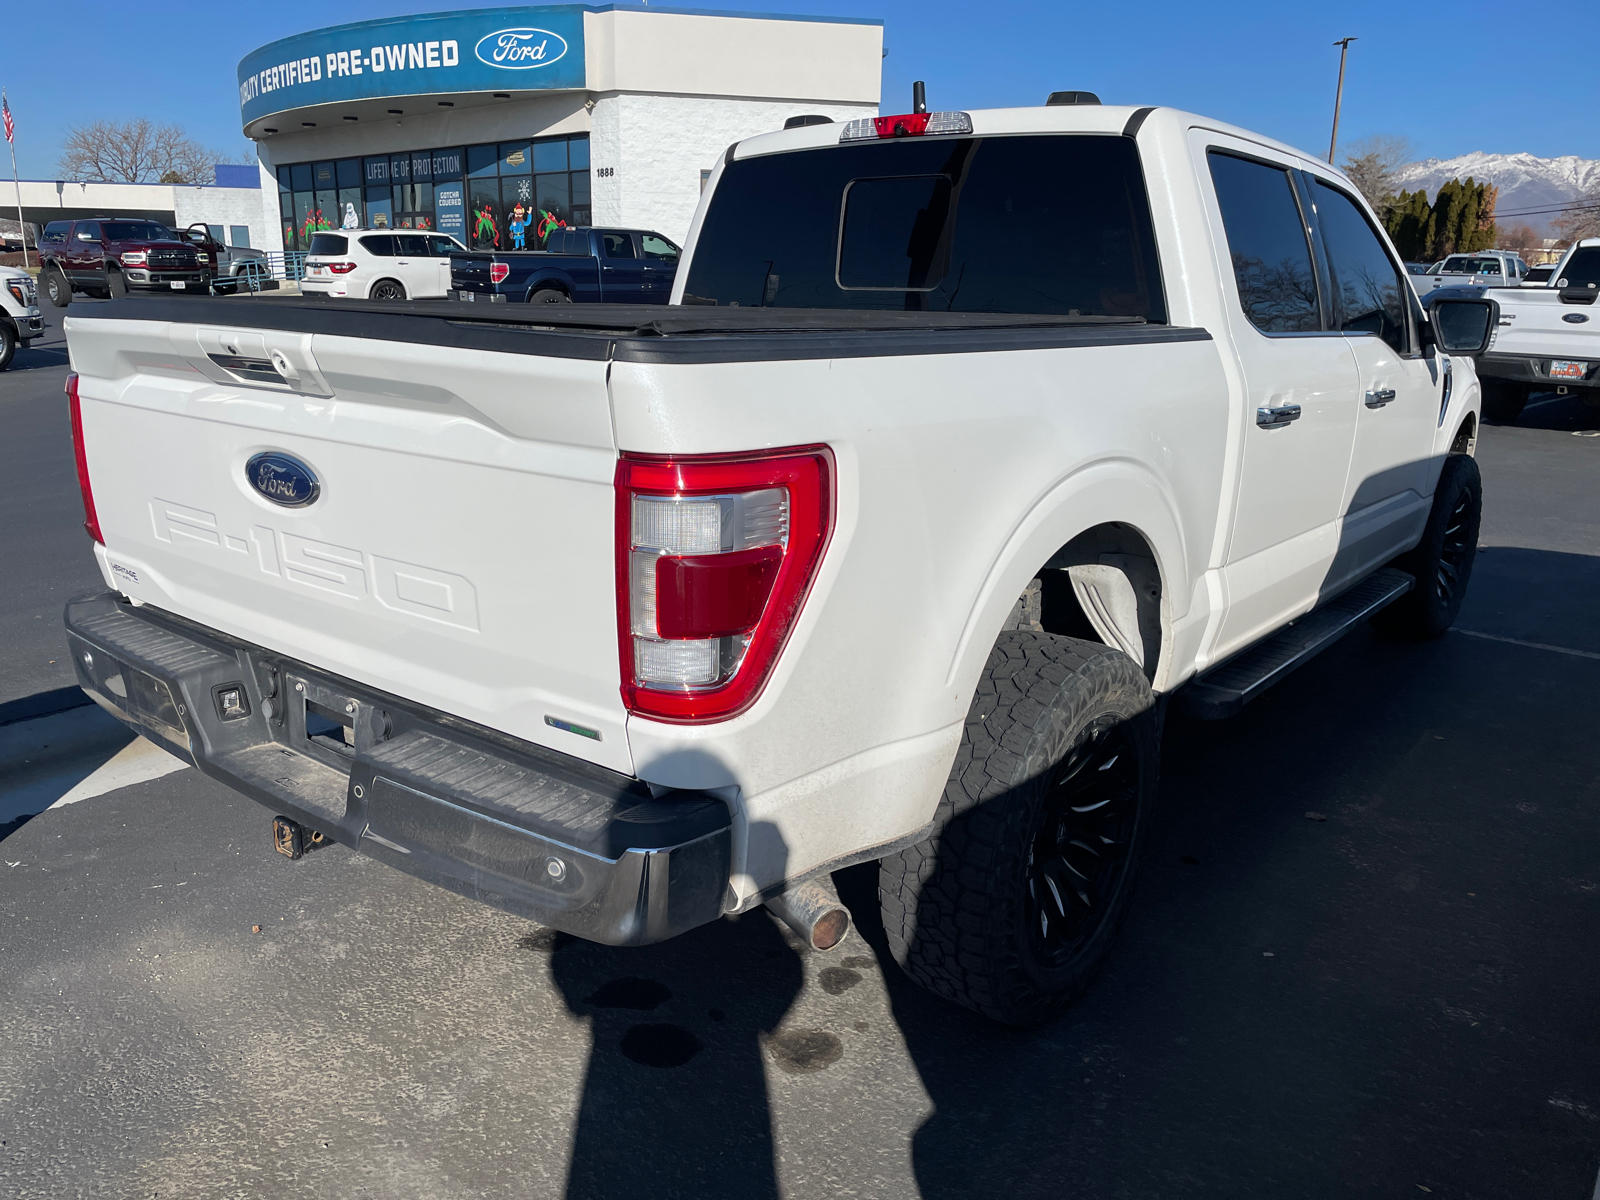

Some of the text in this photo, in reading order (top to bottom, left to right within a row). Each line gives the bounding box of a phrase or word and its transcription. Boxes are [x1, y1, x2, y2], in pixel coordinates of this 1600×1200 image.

[493, 33, 548, 62] Ford
[260, 55, 322, 94] CERTIFIED
[326, 40, 459, 78] PRE-OWNED
[366, 155, 460, 179] LIFETIME OF PROTECTION
[596, 167, 614, 178] 1888
[438, 198, 462, 206] COVERED
[440, 191, 460, 199] GOTCHA
[256, 463, 298, 498] Ford
[148, 496, 481, 634] F-150
